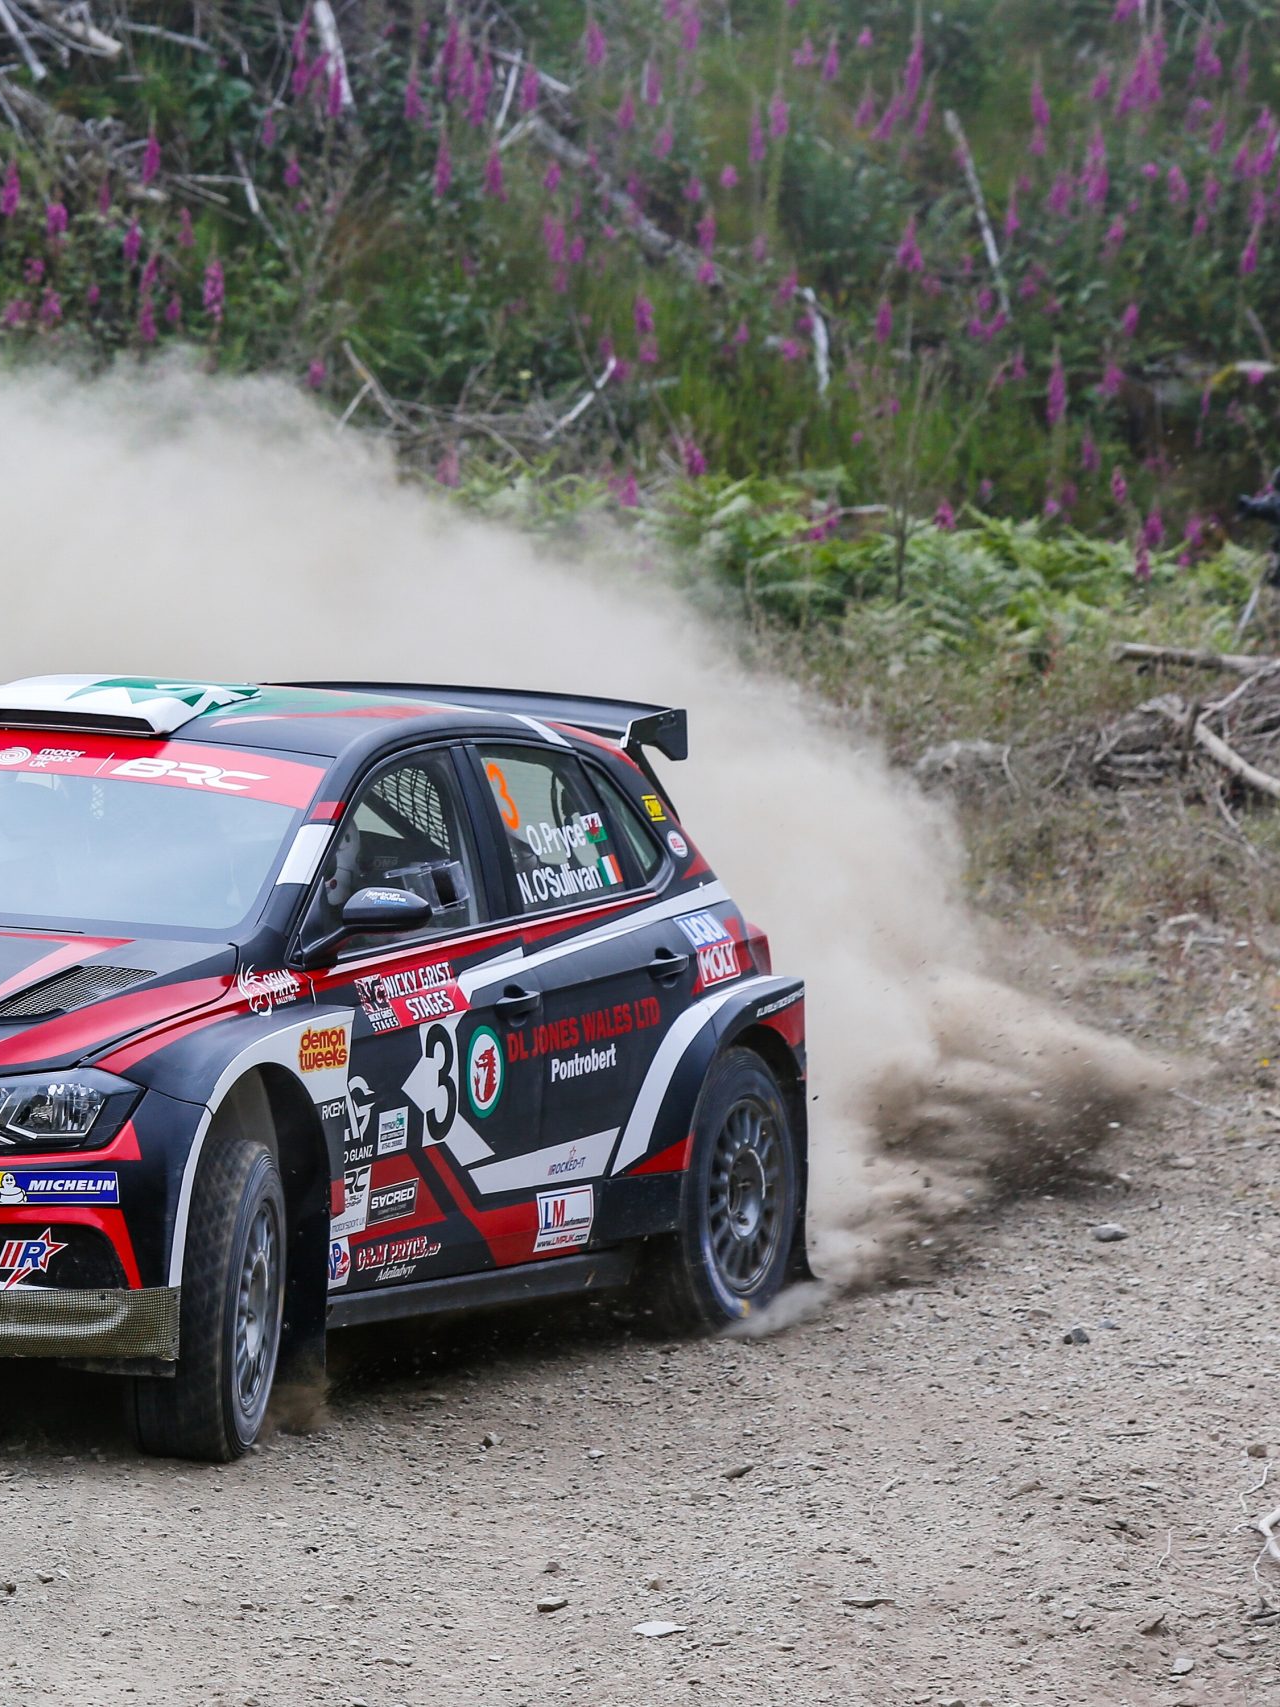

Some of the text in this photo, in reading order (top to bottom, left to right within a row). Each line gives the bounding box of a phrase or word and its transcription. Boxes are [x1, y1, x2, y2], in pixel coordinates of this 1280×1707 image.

[34, 754, 76, 763] sport
[39, 747, 86, 758] motor
[110, 757, 271, 791] BRC
[486, 762, 519, 830] 3
[526, 822, 587, 858] O.Pryce
[516, 862, 604, 905] N.O'Sullivan
[677, 912, 729, 948] LIQUI
[262, 968, 295, 986] OSIAN
[700, 941, 737, 982] MOLY
[270, 981, 301, 998] PRYCE
[382, 961, 453, 999] NICKY GRIST
[405, 990, 455, 1021] STAGES
[300, 1028, 346, 1051] demon
[372, 1016, 400, 1032] STAGES
[507, 998, 660, 1063] DL JONES WALES LTD
[299, 1047, 348, 1071] tweeks
[551, 1043, 618, 1083] Pontrobert
[425, 1023, 457, 1141] 3
[349, 1144, 374, 1162] GLANZ
[28, 1180, 116, 1191] MICHELIN
[543, 1198, 566, 1230] LM
